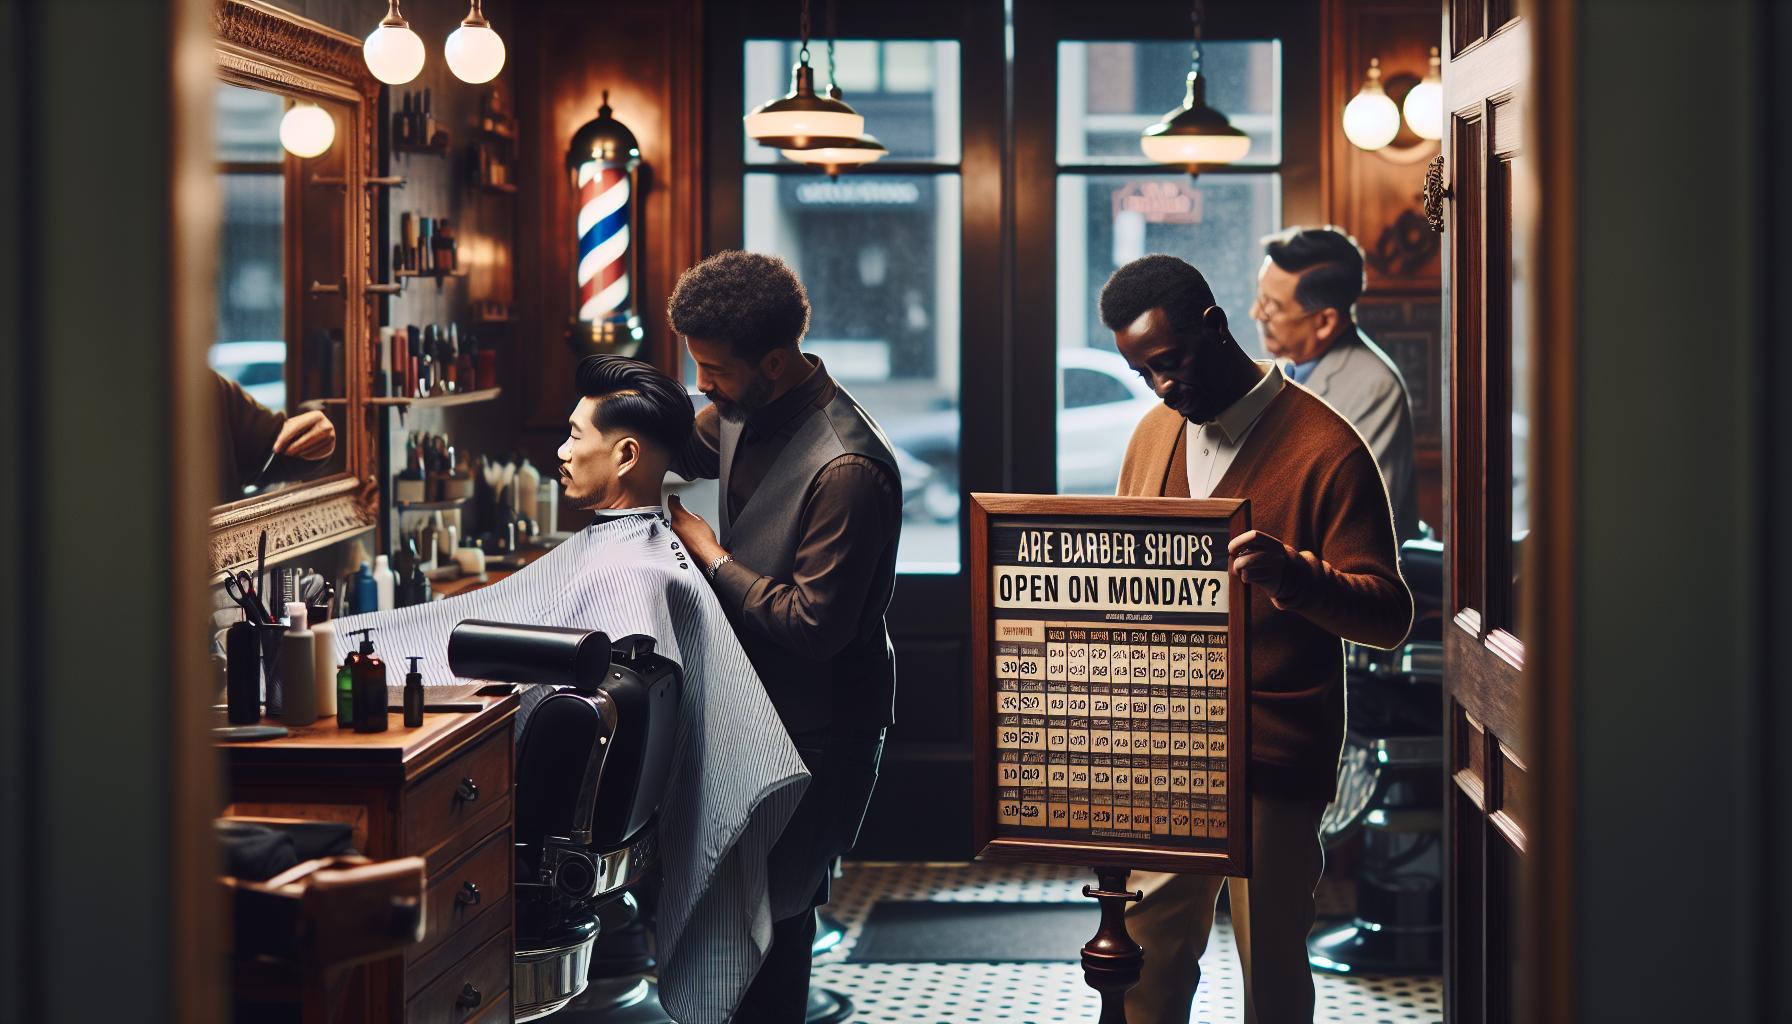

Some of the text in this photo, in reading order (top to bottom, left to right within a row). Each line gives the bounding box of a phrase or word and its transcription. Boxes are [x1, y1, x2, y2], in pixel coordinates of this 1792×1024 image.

[1018, 531, 1213, 566] ARE BARBER SHOPS
[1000, 574, 1221, 606] OPEN ON MONDAY?
